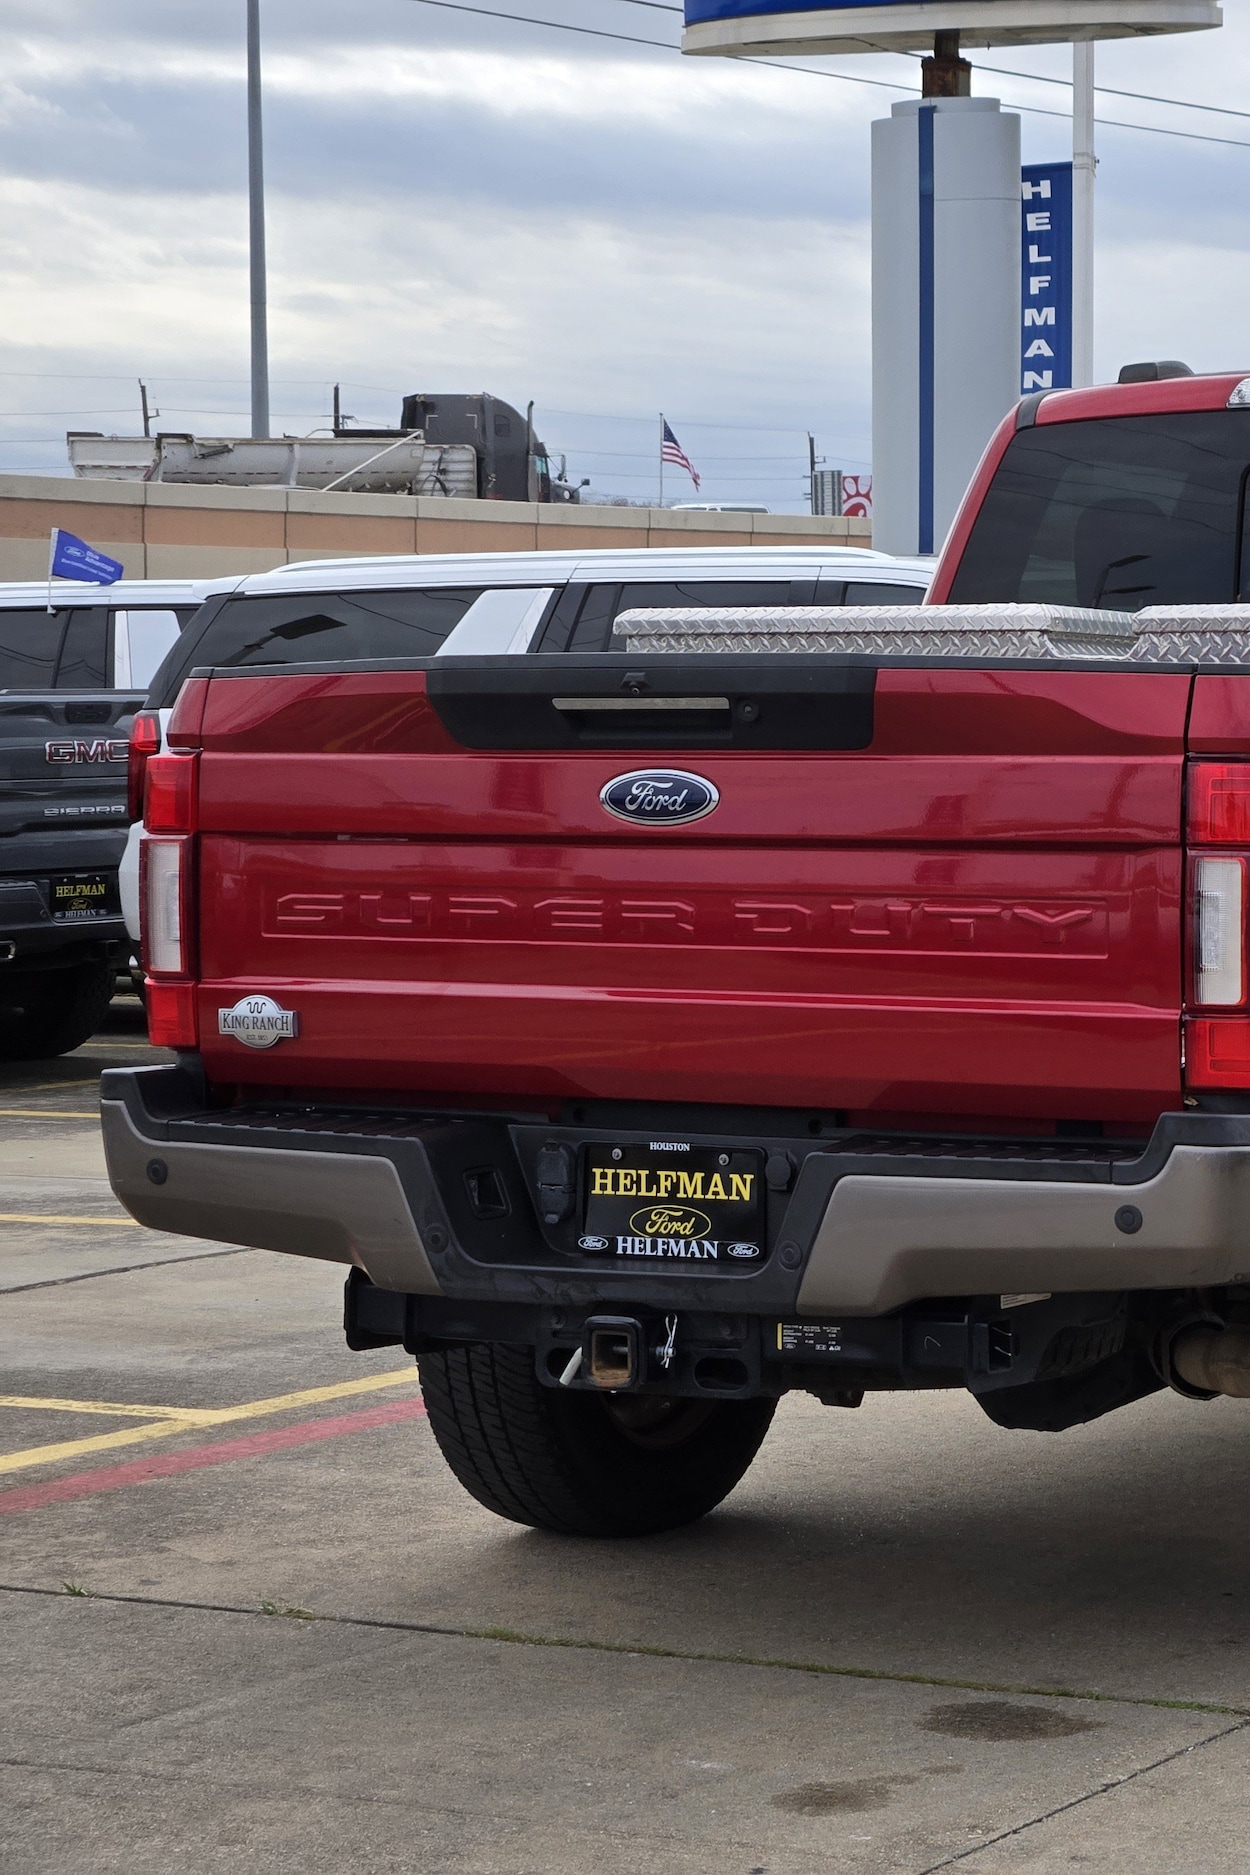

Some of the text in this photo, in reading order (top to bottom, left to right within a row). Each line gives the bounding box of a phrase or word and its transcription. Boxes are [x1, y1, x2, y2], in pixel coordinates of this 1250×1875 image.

[1022, 179, 1055, 388] HELFMAN
[45, 740, 129, 764] GMC
[625, 781, 688, 811] Ford
[44, 805, 125, 817] SIERRA
[56, 884, 106, 897] HELFMAN
[277, 894, 1093, 943] SUPER DUTY
[223, 1013, 289, 1031] KING RANCH
[650, 1142, 690, 1151] HOUSTON
[591, 1168, 754, 1201] HELFMAN
[645, 1208, 696, 1235] Ford
[616, 1236, 719, 1259] HELFMAN
